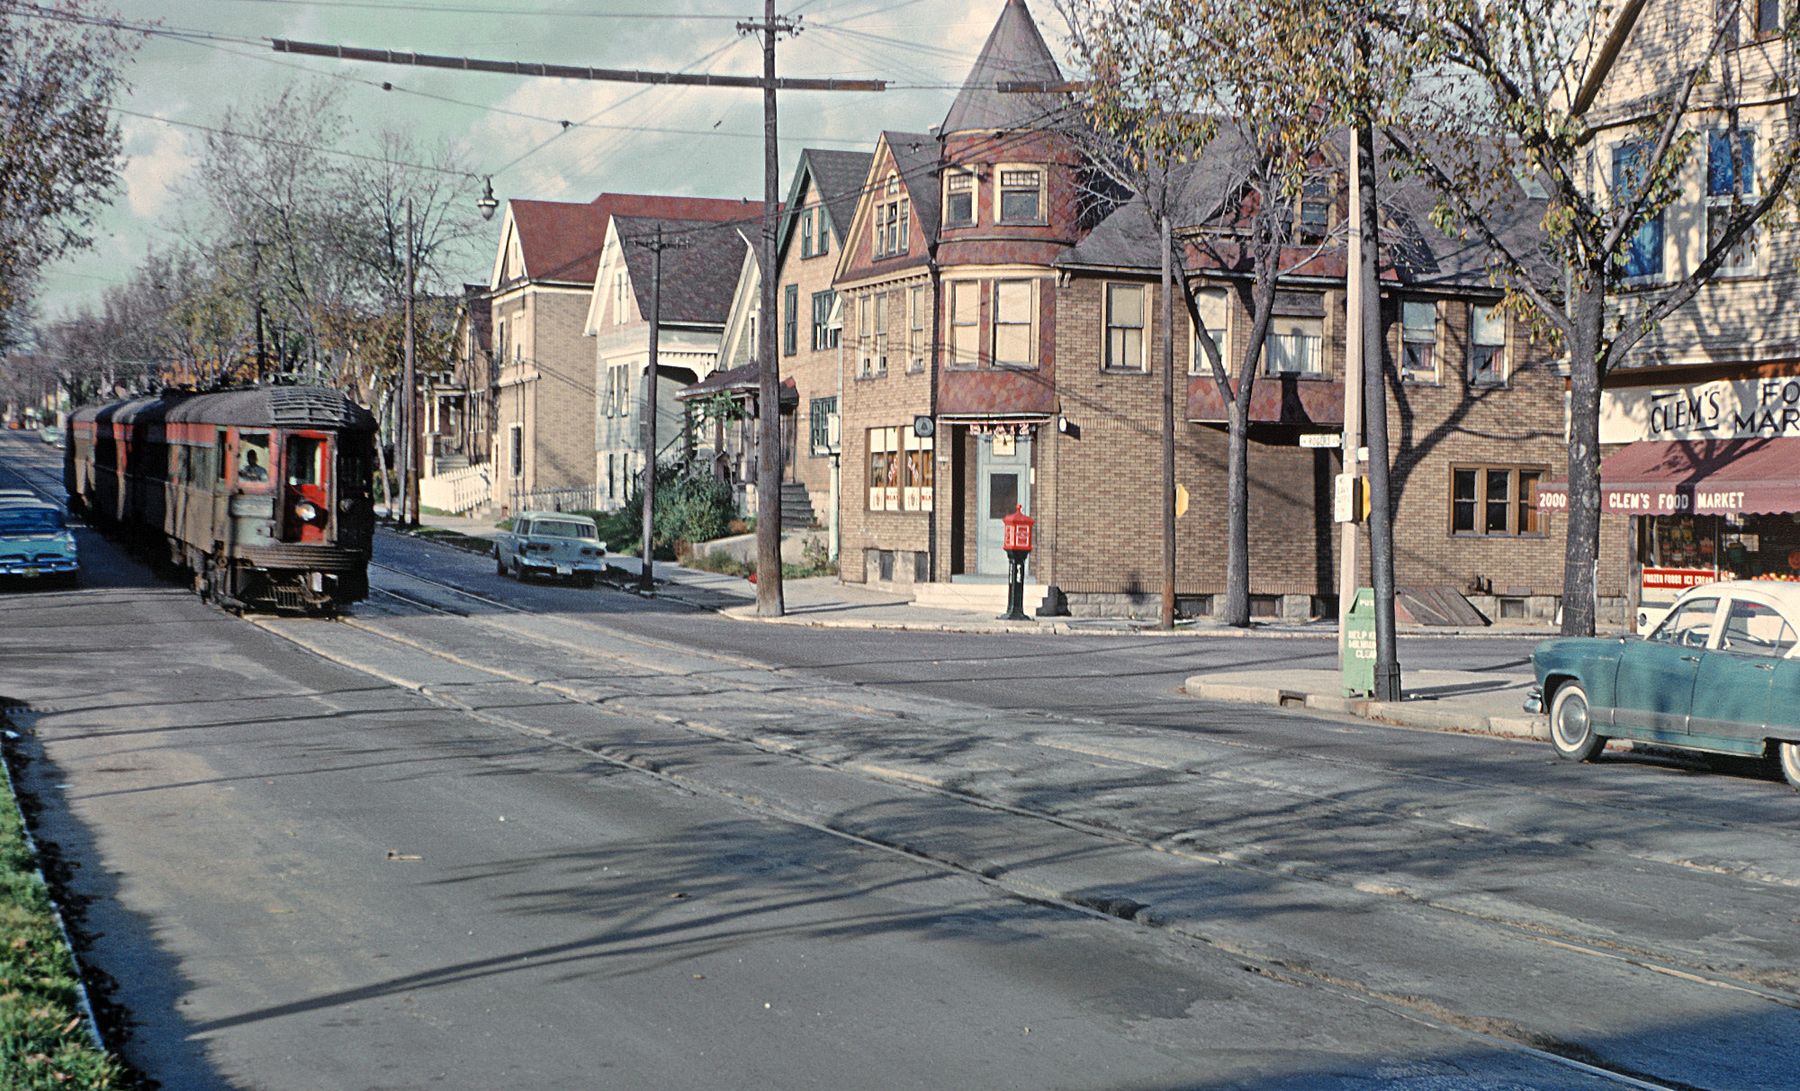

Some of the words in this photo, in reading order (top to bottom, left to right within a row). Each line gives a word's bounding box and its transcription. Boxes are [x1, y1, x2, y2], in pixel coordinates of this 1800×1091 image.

[1651, 391, 1720, 434] CLEM'S
[969, 422, 1030, 435] BLATZ
[1539, 493, 1567, 508] 2000
[1609, 493, 1650, 509] CLEM'S
[1658, 494, 1689, 509] FOOD
[1697, 492, 1744, 509] MARKET
[1643, 573, 1664, 584] FROZEN
[1664, 574, 1682, 585] FOODS
[1684, 575, 1693, 585] ICE
[1694, 575, 1714, 585] CREAM
[1359, 599, 1375, 607] PUS
[1348, 630, 1367, 640] HELP
